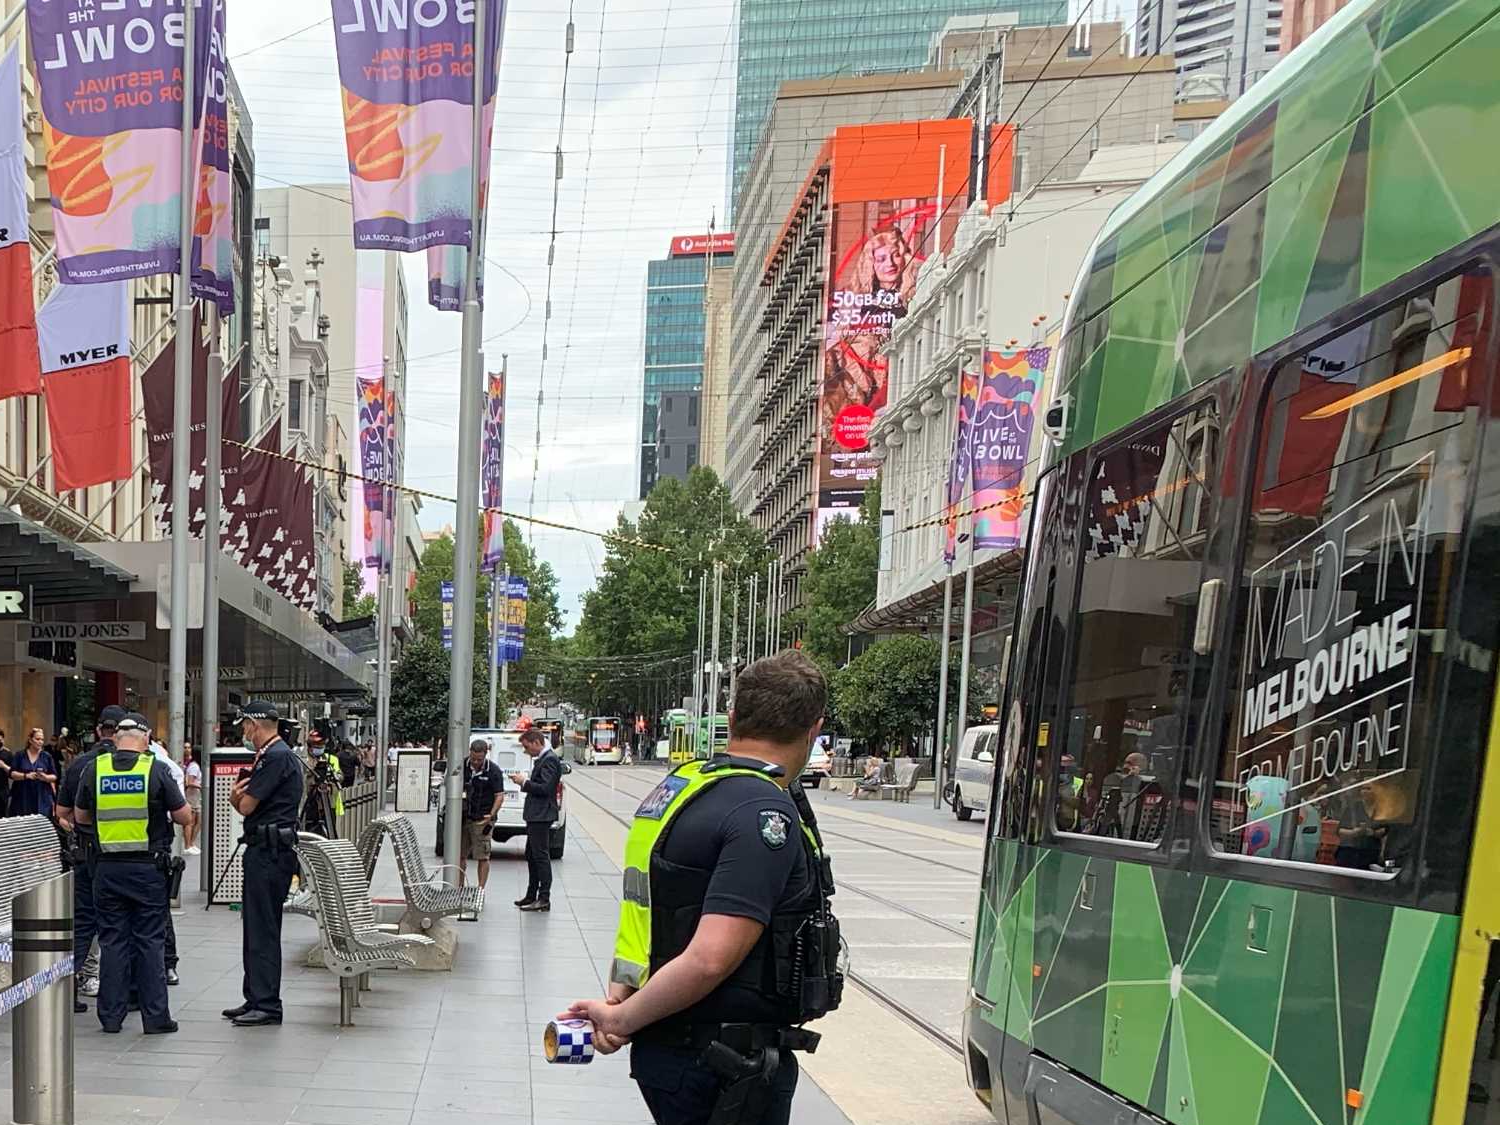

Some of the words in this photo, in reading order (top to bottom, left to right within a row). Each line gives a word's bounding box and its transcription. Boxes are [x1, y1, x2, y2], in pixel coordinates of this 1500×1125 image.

[832, 291, 873, 307] 50GB
[874, 289, 902, 305] for
[831, 309, 896, 327] $35/mth
[59, 343, 119, 366] MYER
[973, 427, 1009, 444] LIVE
[974, 445, 1024, 460] BOWL
[1249, 514, 1370, 674] MADE
[1375, 498, 1415, 604] IN
[31, 624, 77, 639] DAVID
[78, 623, 130, 638] JONES
[1243, 604, 1412, 738] MELBOURNE
[1276, 703, 1404, 792] MELBOURNE
[100, 778, 143, 792] Police
